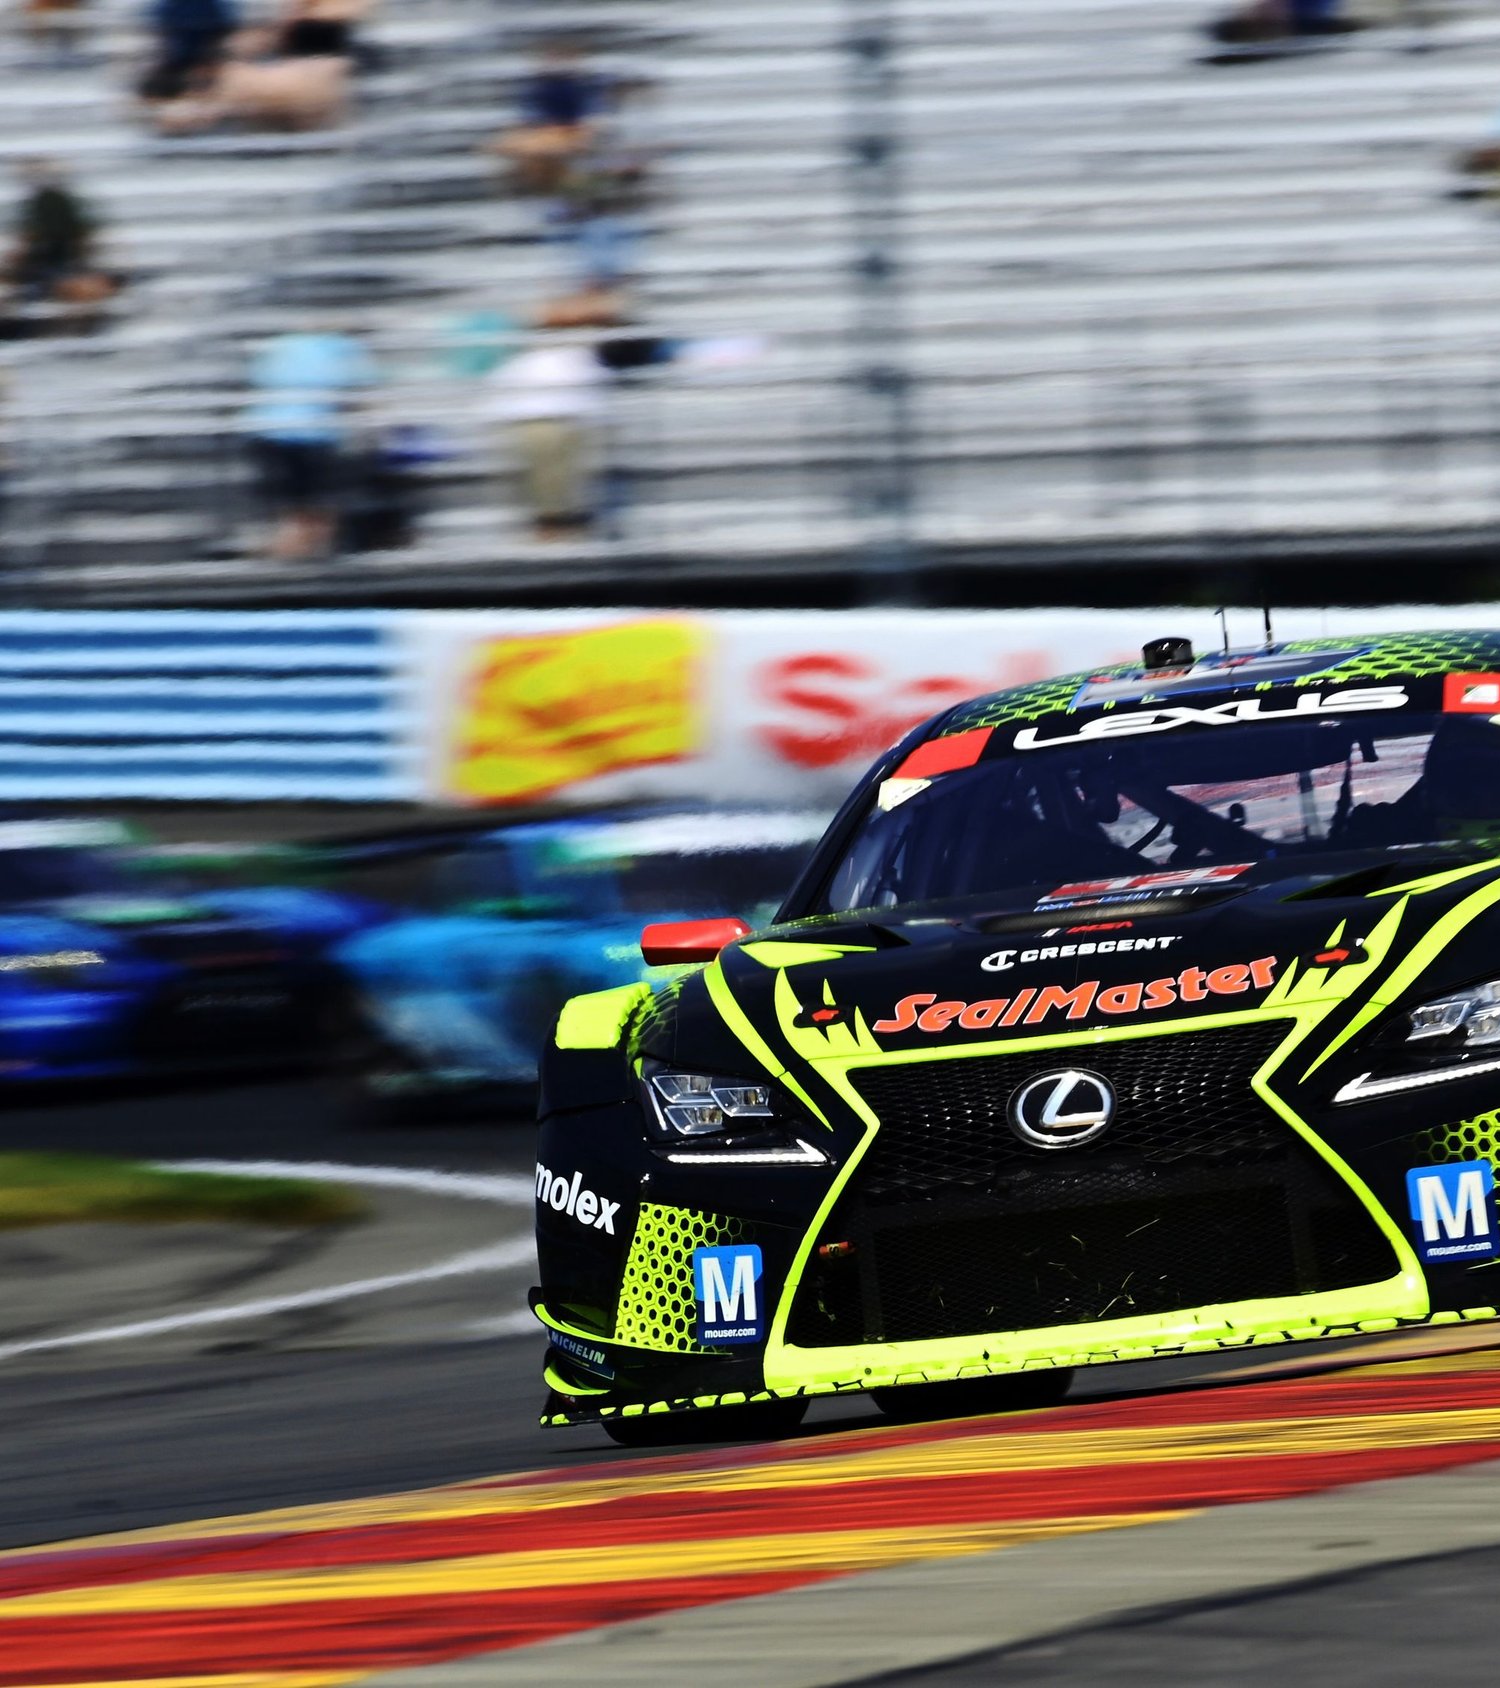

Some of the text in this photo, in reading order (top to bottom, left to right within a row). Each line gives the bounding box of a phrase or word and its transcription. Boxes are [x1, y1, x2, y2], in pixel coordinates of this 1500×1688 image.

[1013, 685, 1410, 750] LEXUS
[1020, 936, 1177, 964] CRESCENT
[872, 955, 1278, 1030] SealMaster
[1416, 1170, 1490, 1242] M
[1426, 1241, 1493, 1257] mouser.com
[701, 1255, 758, 1323] M
[551, 1332, 606, 1365] MICHELIN
[704, 1327, 757, 1339] mouser.com
